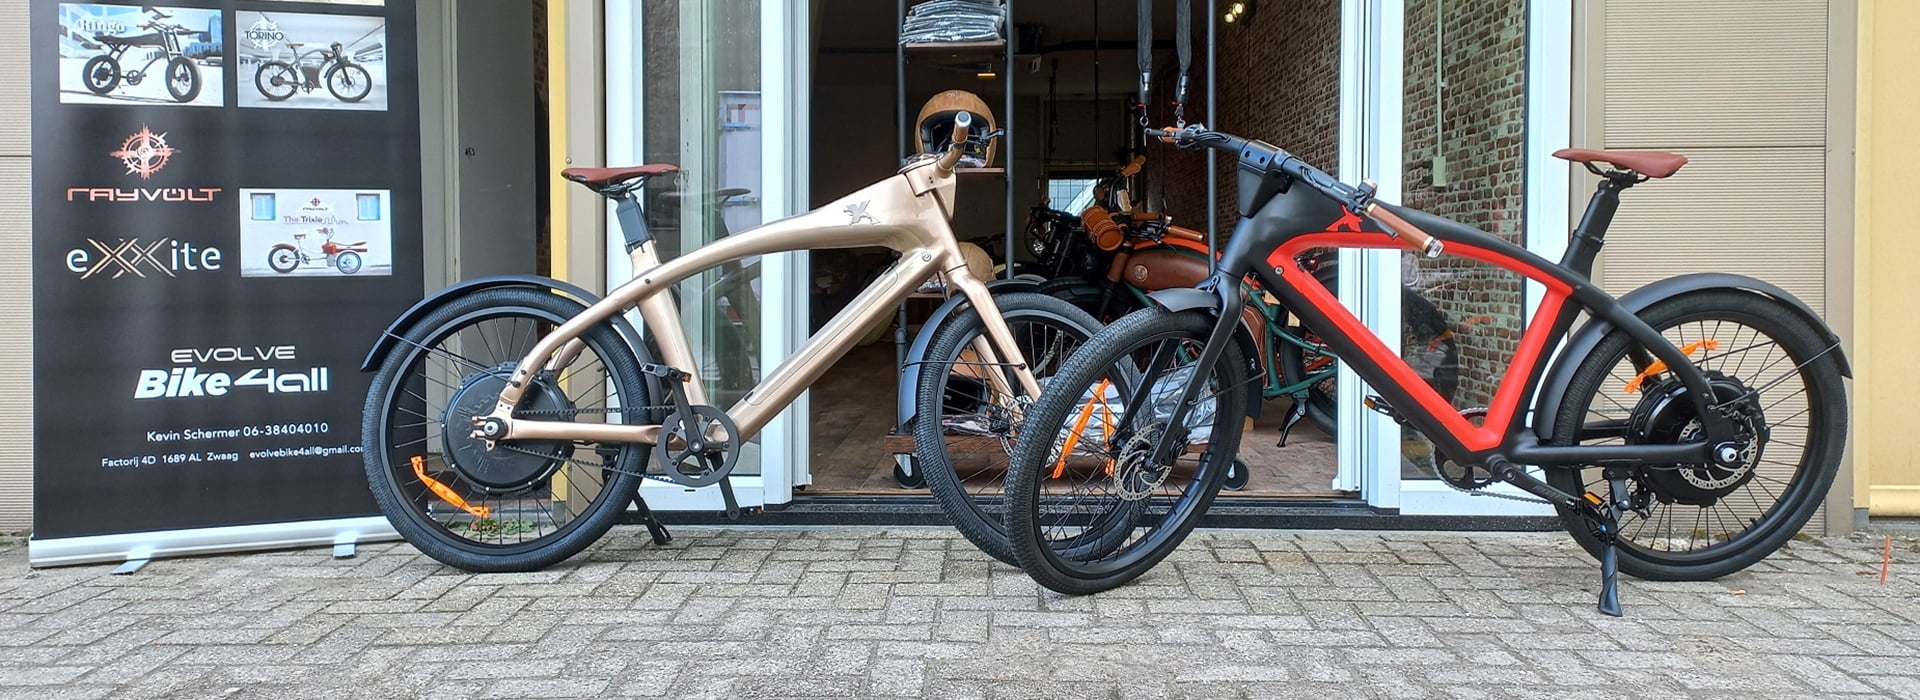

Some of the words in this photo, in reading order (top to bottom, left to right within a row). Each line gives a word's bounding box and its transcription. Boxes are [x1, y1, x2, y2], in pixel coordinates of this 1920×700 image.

[245, 31, 284, 41] TORINO
[171, 346, 296, 363] EVOLVE
[147, 431, 180, 442] Kevin
[183, 428, 241, 440] Schermer
[243, 422, 328, 437] 06-38404010
[101, 457, 139, 468] Factorij
[141, 455, 156, 465] 4D
[162, 453, 186, 464] 1689
[188, 453, 202, 463] AL
[206, 452, 239, 462] Zwaag
